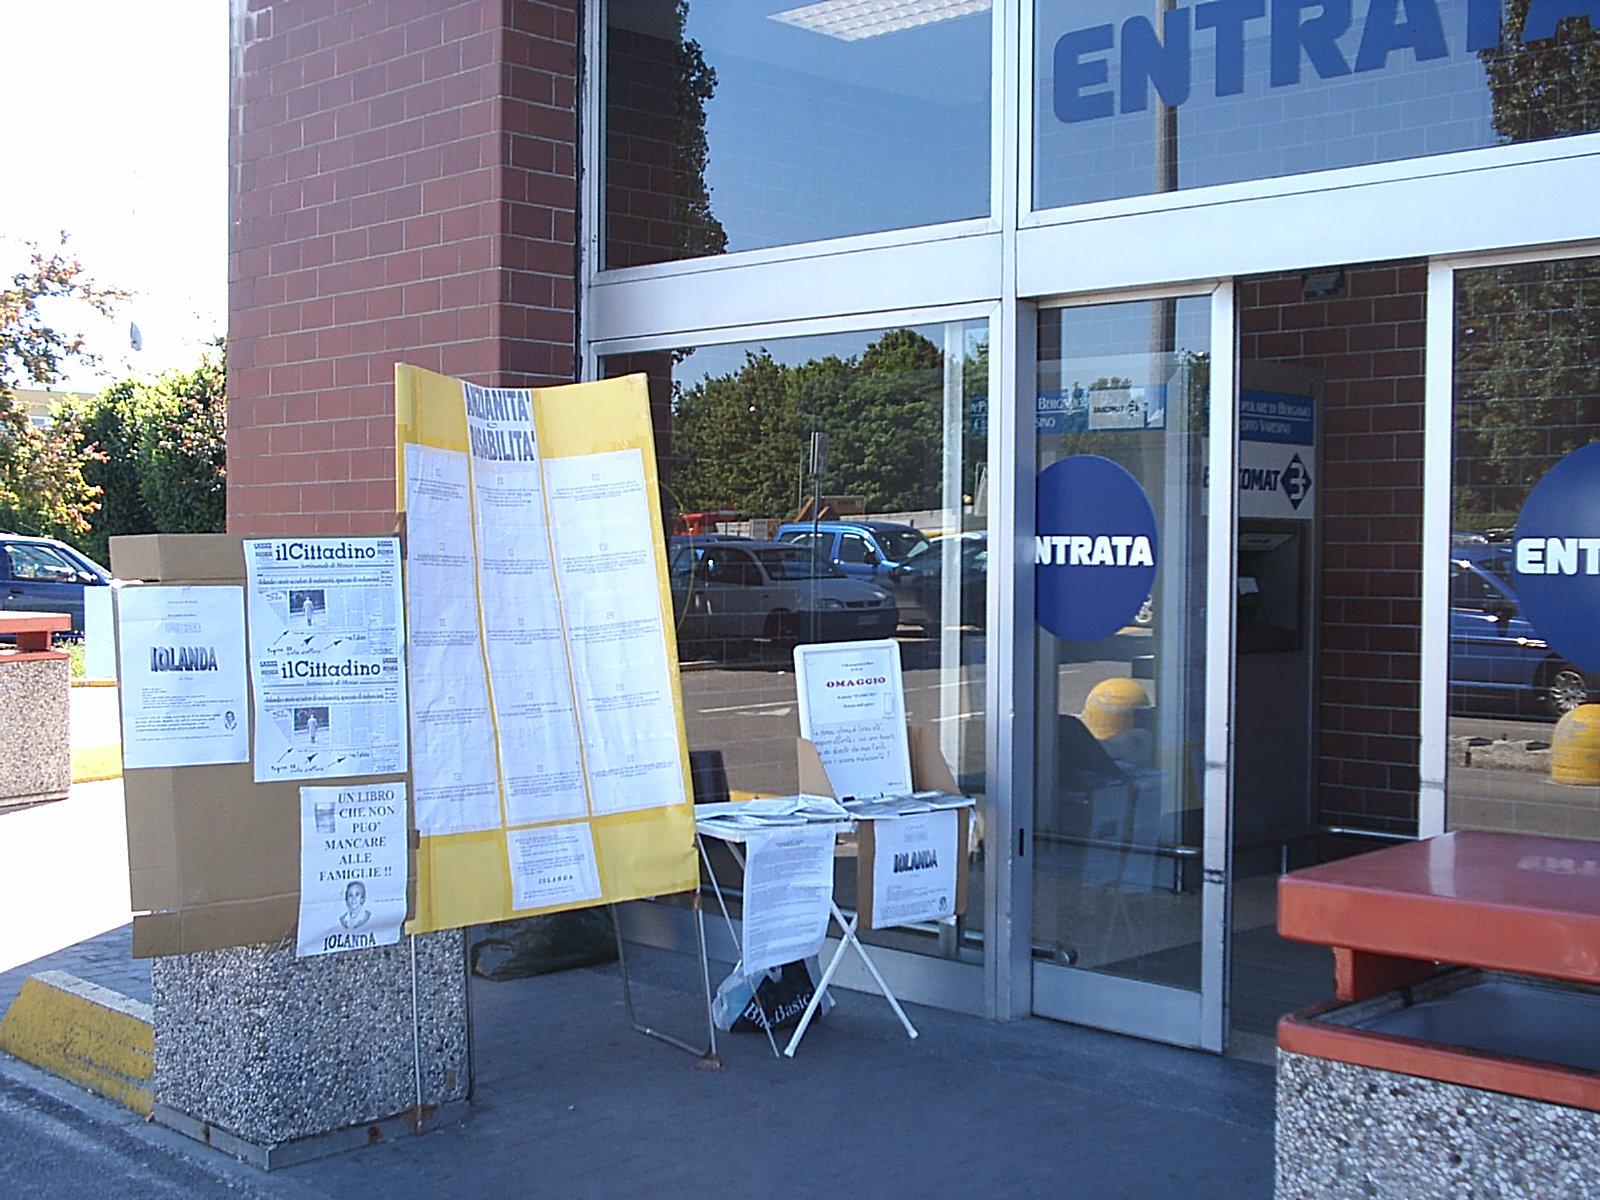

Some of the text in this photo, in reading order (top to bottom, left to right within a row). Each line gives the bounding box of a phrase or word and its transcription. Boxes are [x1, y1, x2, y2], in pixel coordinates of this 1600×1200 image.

[1035, 535, 1154, 566] NTRATA
[149, 646, 218, 672] IOLANDA
[826, 676, 887, 688] OMAGGIO
[338, 790, 395, 804] UN LIBRO
[339, 805, 395, 819] CHE NON
[325, 836, 387, 851] MANCARE
[339, 853, 372, 865] ALLE
[893, 849, 938, 873] IOLANDA
[323, 931, 377, 951] IOLANDA
